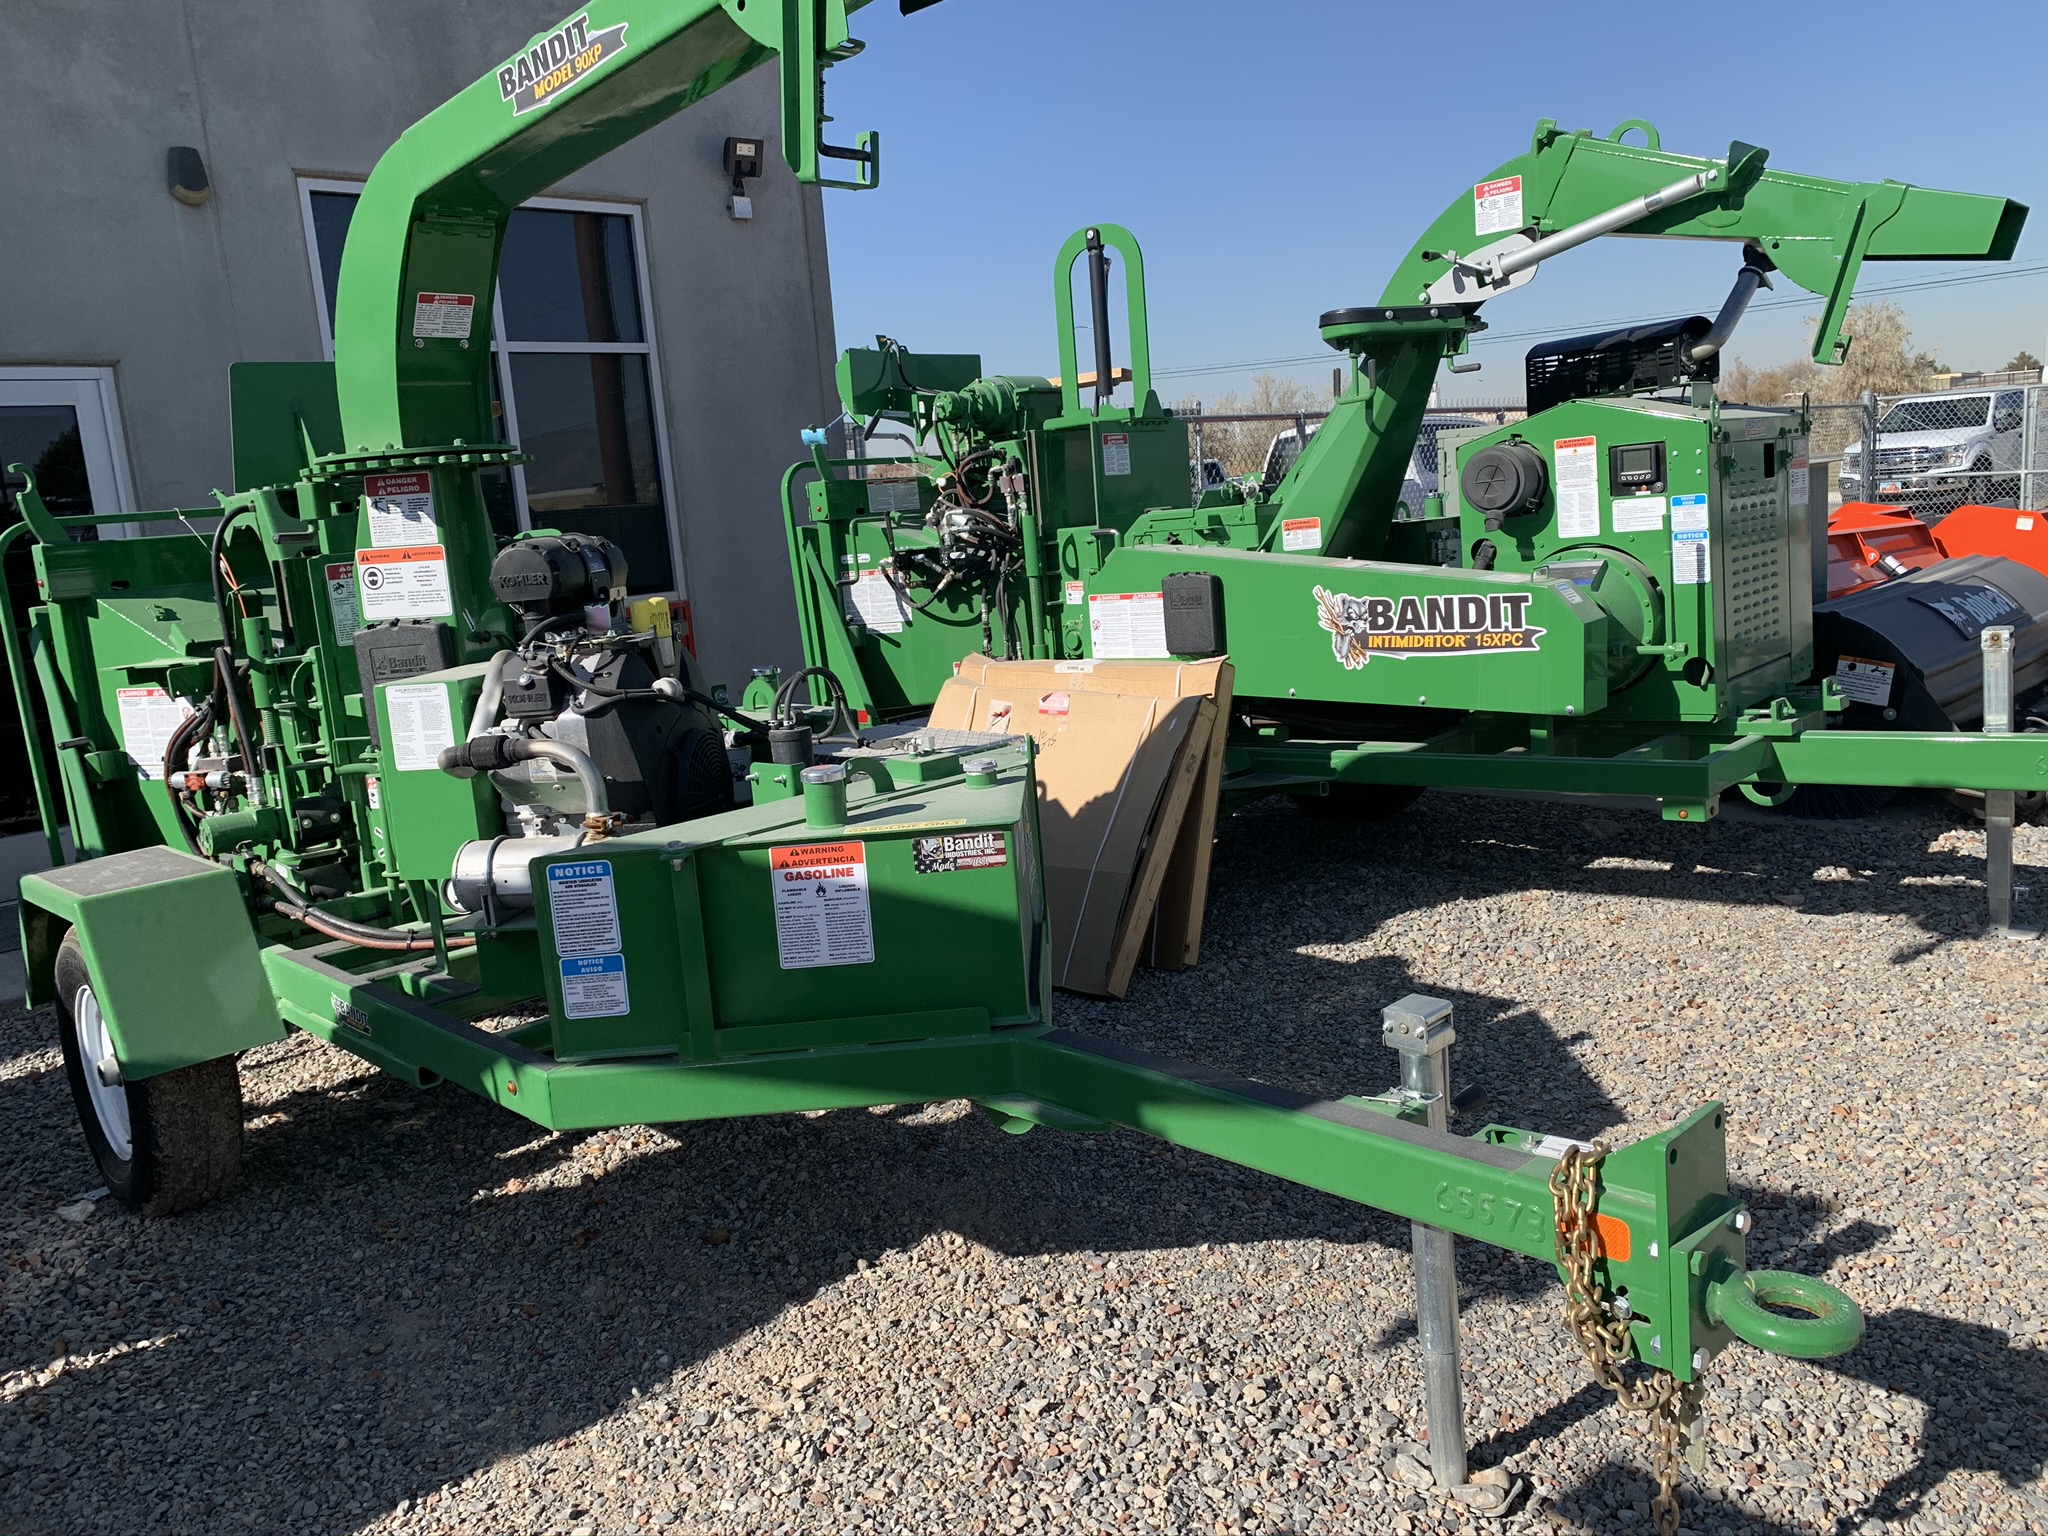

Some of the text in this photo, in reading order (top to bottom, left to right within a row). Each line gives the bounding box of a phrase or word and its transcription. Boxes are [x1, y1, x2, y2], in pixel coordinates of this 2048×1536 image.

[499, 14, 588, 98] BANDIT
[533, 43, 602, 100] MODEL 90XP
[1489, 180, 1512, 189] DANGER
[1489, 186, 1514, 195] PELIGRO
[385, 476, 418, 485] DANGER
[386, 485, 420, 493] PELIGRO
[1676, 532, 1704, 540] NOTICE
[498, 573, 550, 589] KOHLER
[1368, 594, 1530, 631] BANDIT
[1368, 633, 1523, 649] INTIMIDATOR 15XPC
[389, 655, 428, 669] Bandit
[508, 692, 547, 704] KOHLER
[848, 819, 963, 833] GASOLINE ONLY
[944, 833, 995, 853] Bandit
[800, 846, 845, 855] WARNING
[945, 849, 984, 858] INDUSTRIES,
[791, 856, 856, 867] ADVERTENCIA
[932, 860, 955, 871] Made
[554, 865, 604, 877] NOTICE
[784, 867, 855, 882] GASOLINE
[577, 958, 604, 966] NOTICE
[1434, 1181, 1546, 1243] 65573
